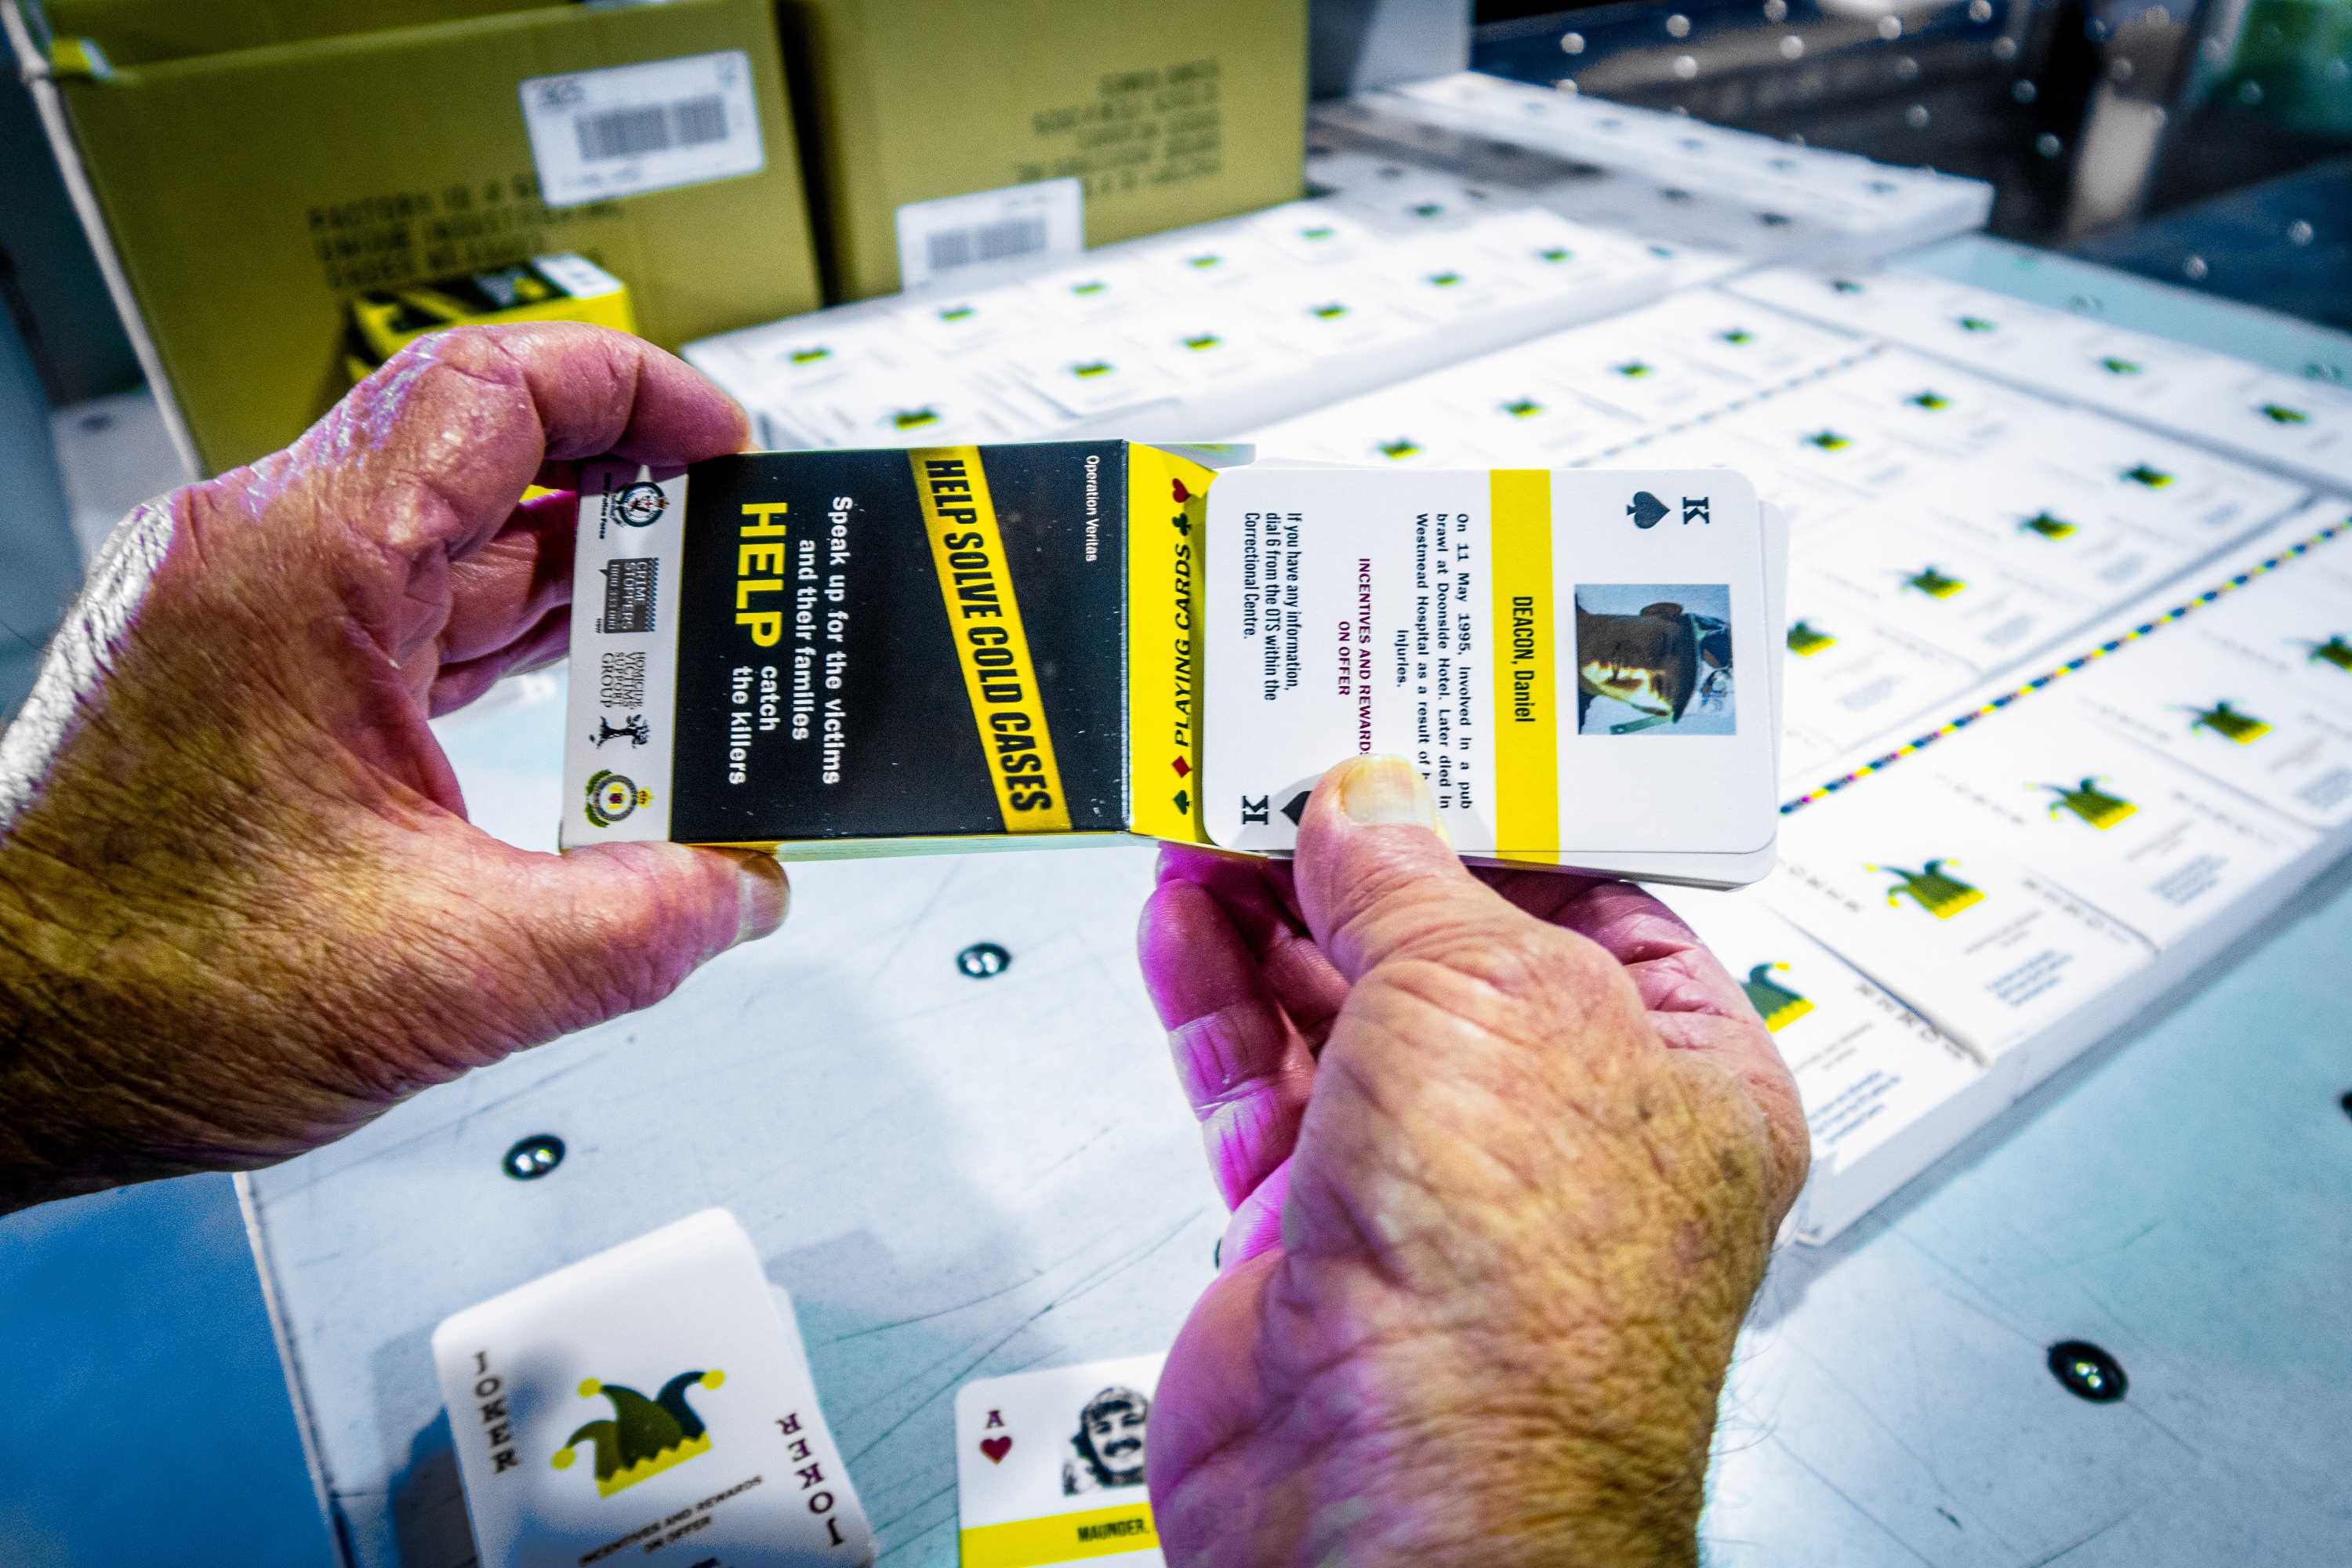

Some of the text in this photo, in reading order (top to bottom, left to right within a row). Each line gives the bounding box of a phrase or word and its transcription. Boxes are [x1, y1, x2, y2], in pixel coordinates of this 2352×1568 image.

[1085, 455, 1100, 562] Operation Veritas
[1265, 513, 1280, 535] dial
[1457, 514, 1468, 532] On
[1682, 496, 1710, 524] K
[735, 503, 788, 648] HELP
[1243, 513, 1260, 639] Correctional Centre.
[1265, 550, 1280, 580] from
[1416, 513, 1428, 589] Westmead
[1457, 543, 1469, 561] 11
[620, 562, 635, 631] STOPPERS
[1265, 584, 1280, 604] the
[1283, 513, 1302, 691] If you have any information,
[1359, 558, 1370, 644] INCENTIVES
[1455, 572, 1469, 601] May
[792, 539, 818, 741] and their families
[822, 496, 853, 785] Speak up for the victims
[925, 459, 1053, 812] HELP SOLVE COLD CASES
[1174, 543, 1192, 748] PLAYING CARDS
[1265, 608, 1281, 631] OTS
[1415, 596, 1429, 655] Hospital
[1457, 614, 1471, 655] 1995,
[600, 652, 615, 708] GROUP
[613, 652, 625, 707] SUPPORT
[633, 652, 646, 708] HOMICIDE
[1265, 635, 1280, 676] within
[1338, 621, 1350, 695] ON OFFER
[1359, 648, 1370, 680] AND
[1394, 630, 1409, 688] injuries.
[1417, 662, 1426, 679] as
[1436, 514, 1451, 809] brawl at Doonside Hotel. Later died in
[1511, 596, 1536, 722] DEACON, Daniel
[758, 666, 781, 731] catch
[1264, 680, 1279, 701] the
[1417, 686, 1427, 695] a
[1459, 667, 1472, 726] involved
[728, 666, 753, 785] the killers
[1417, 702, 1429, 743] result
[1460, 737, 1472, 750] in
[1417, 751, 1431, 765] of
[1242, 795, 1269, 825] K
[1458, 782, 1472, 809] pub
[473, 1351, 521, 1474] JOKER
[985, 1410, 1005, 1429] A
[775, 1412, 846, 1548] JOKER
